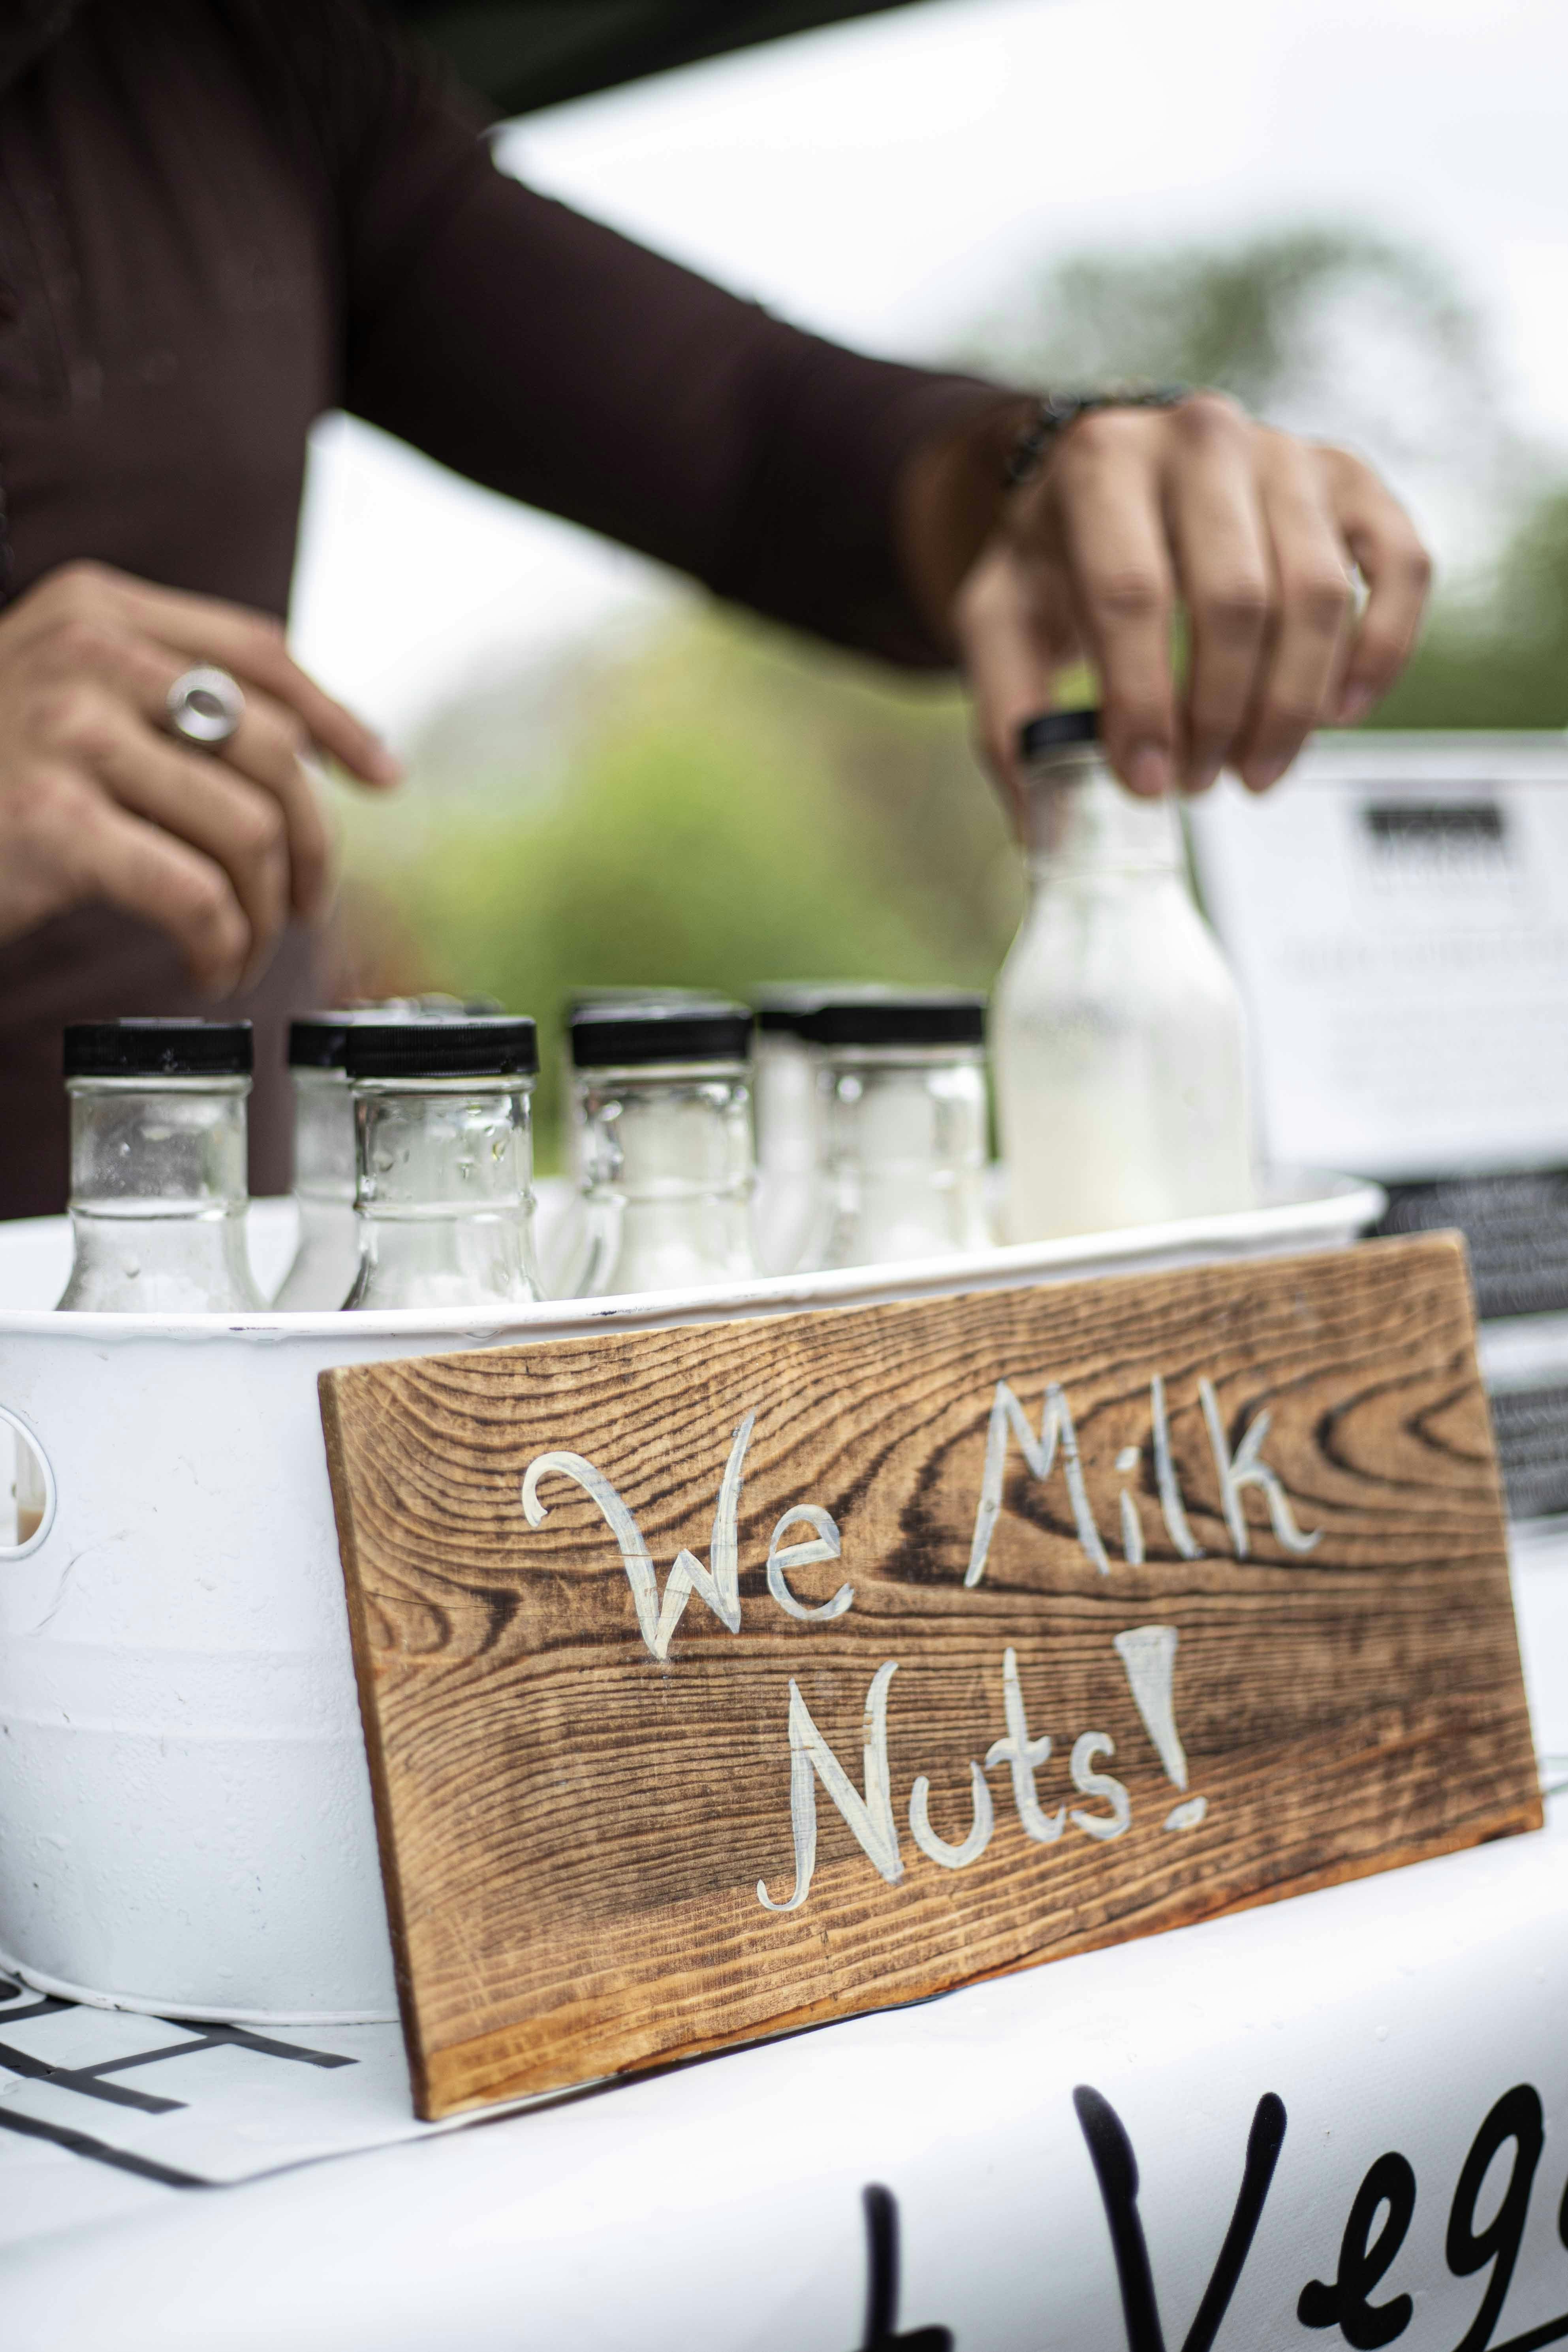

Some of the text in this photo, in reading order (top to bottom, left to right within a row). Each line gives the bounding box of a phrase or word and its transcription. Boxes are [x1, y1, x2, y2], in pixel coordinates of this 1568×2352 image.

[521, 1408, 854, 1661] We
[965, 1374, 1323, 1588] Milk
[756, 1624, 1208, 1912] Nuts!
[1072, 2083, 1568, 2352] Veg
